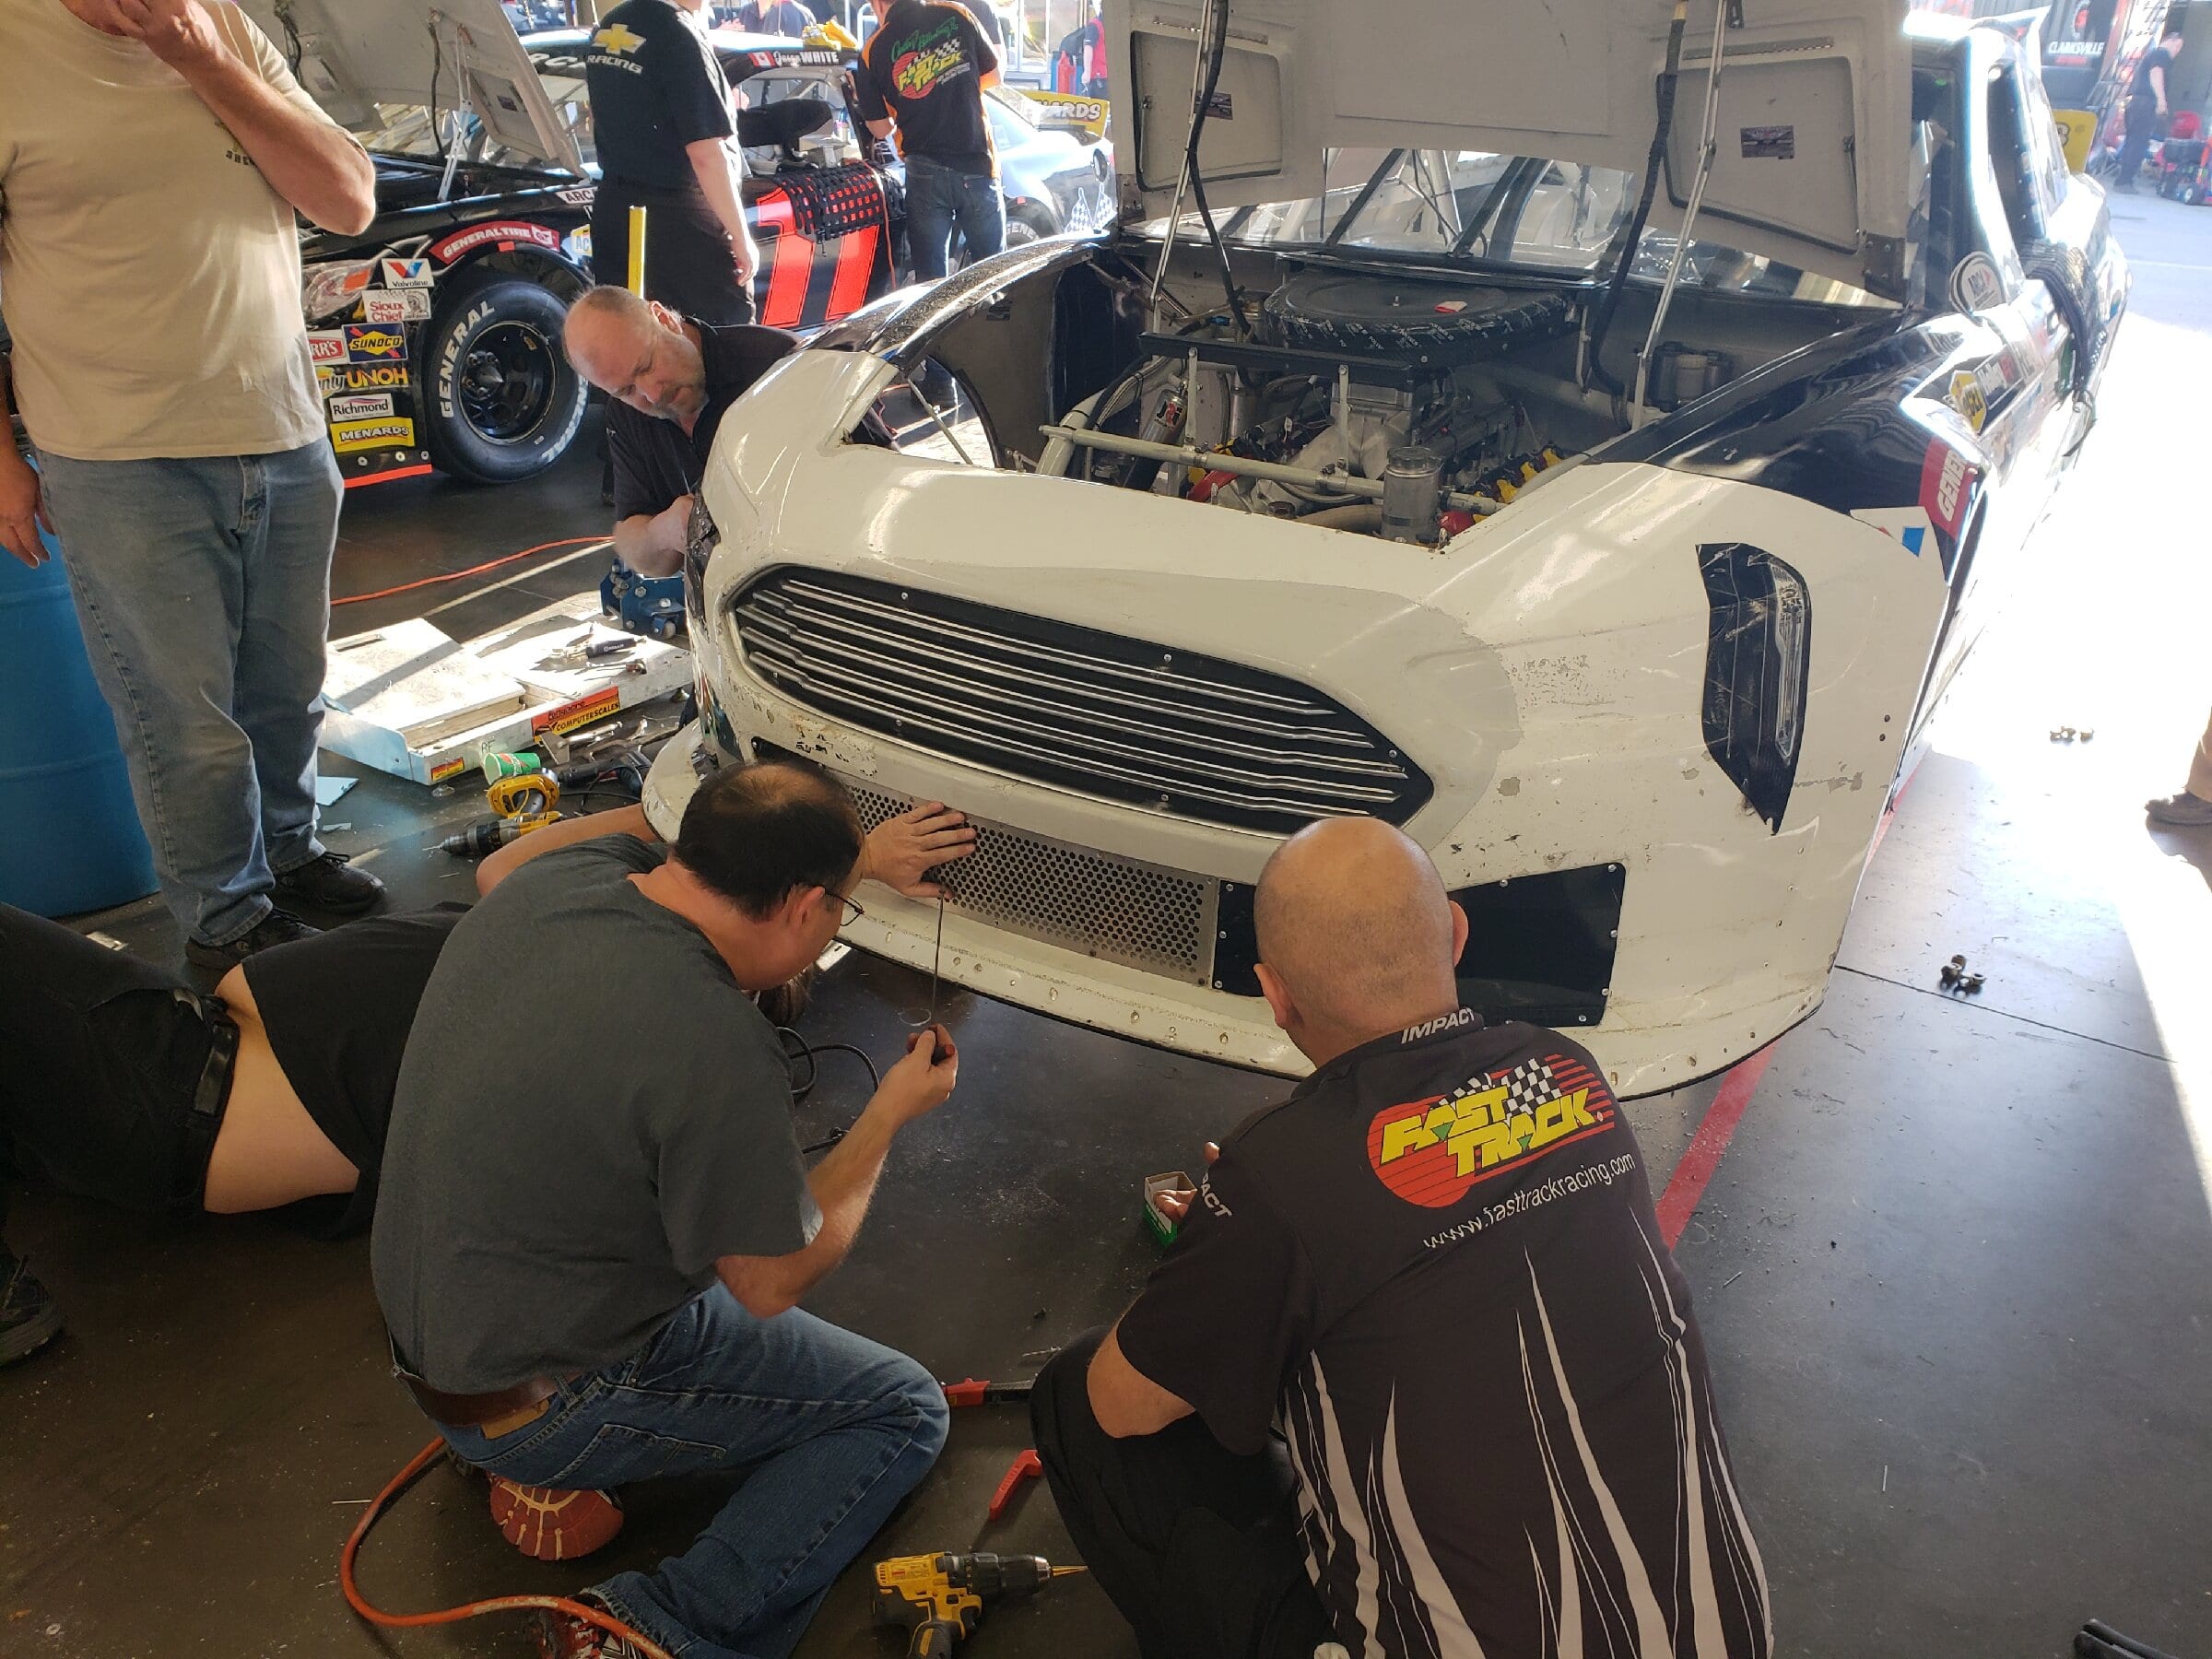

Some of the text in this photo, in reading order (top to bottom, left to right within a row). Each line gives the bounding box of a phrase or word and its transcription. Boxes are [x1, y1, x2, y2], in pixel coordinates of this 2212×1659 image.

[799, 51, 840, 65] WHITE
[2048, 41, 2105, 55] CLARKSVILLE
[587, 54, 643, 74] RACING
[443, 228, 502, 258] GENERAL
[392, 279, 429, 288] Valvoline
[370, 301, 404, 312] Sioux
[371, 312, 403, 323] Chief
[352, 336, 400, 349] SUNOCO
[439, 301, 495, 418] GENERAL
[346, 367, 408, 388] UNOH
[333, 399, 388, 415] Richmond
[341, 426, 410, 441] MENARDS
[556, 702, 619, 731] COMPUTER SCALES
[1401, 1007, 1475, 1044] IMPACT
[1381, 1083, 1509, 1165] FAST
[1447, 1087, 1596, 1179] TRACK
[1423, 1152, 1637, 1249] www.fasttrackracing.com
